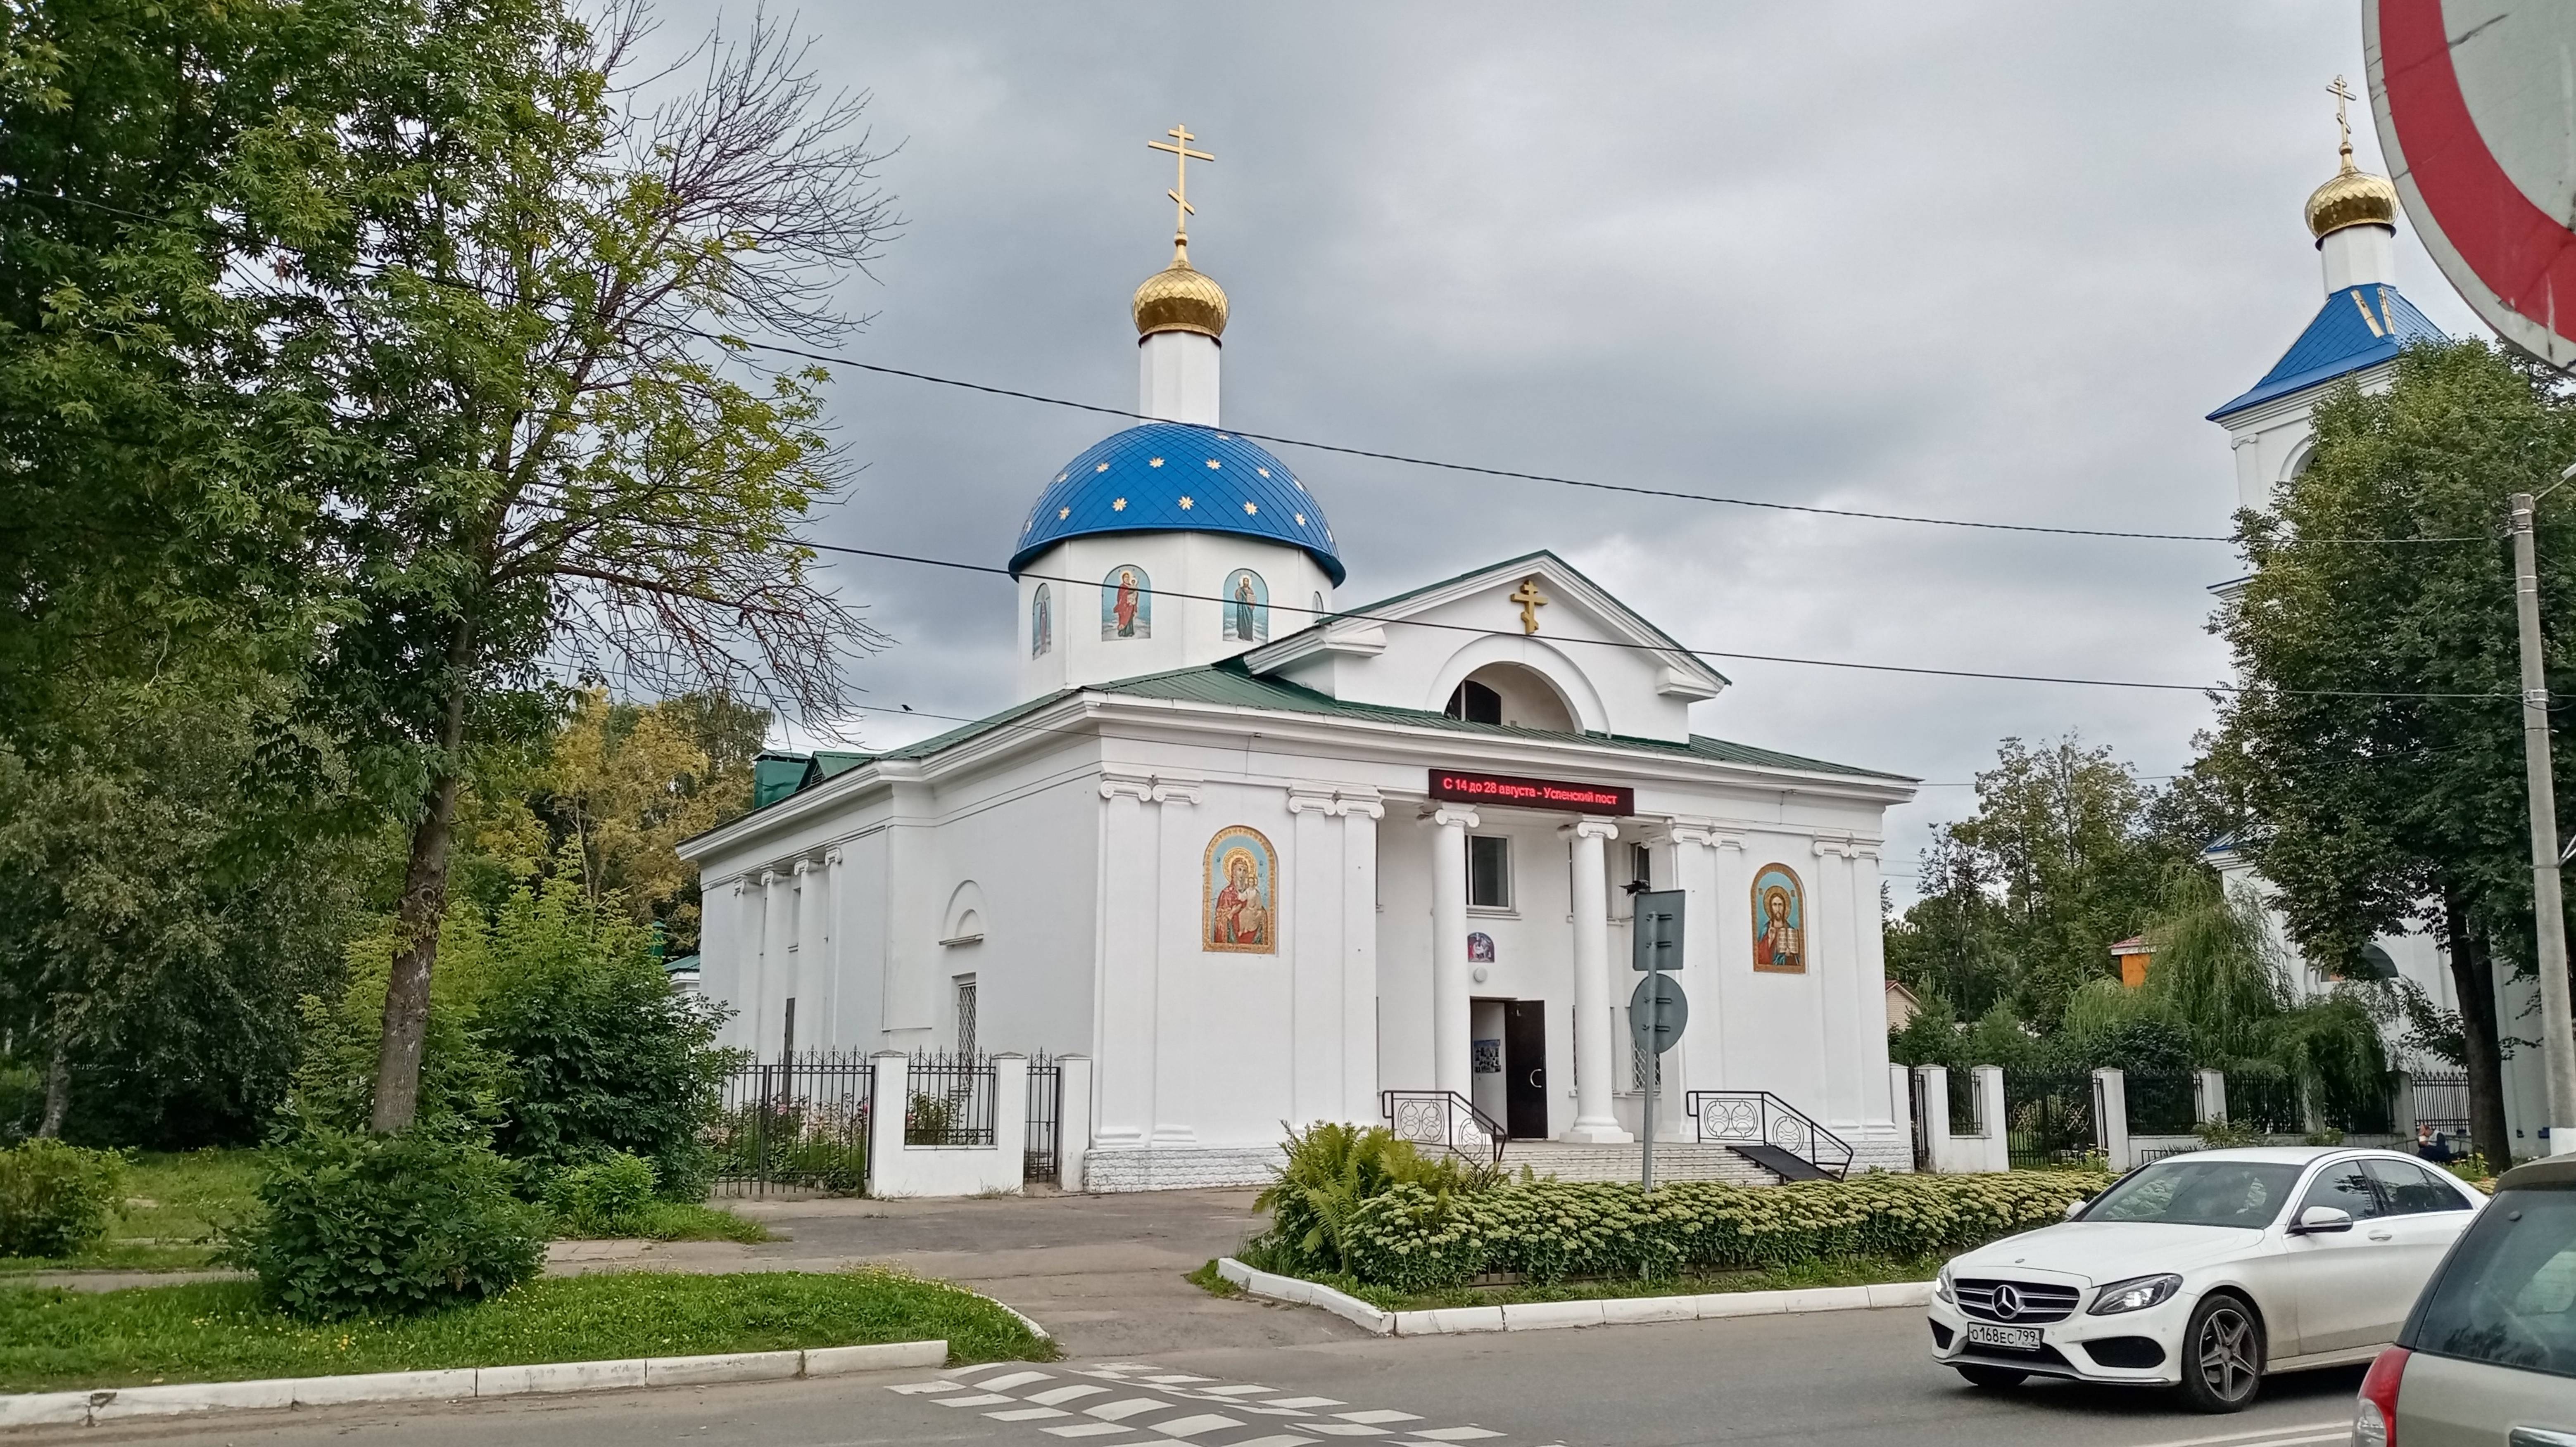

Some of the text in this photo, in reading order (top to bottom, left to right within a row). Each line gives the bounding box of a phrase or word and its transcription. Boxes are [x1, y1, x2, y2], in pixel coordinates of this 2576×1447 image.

[1443, 778, 1453, 790] С
[1455, 779, 1467, 791] 14
[1469, 782, 1483, 793] до
[1484, 781, 1497, 794] 28
[1499, 785, 1535, 798] августа
[1543, 787, 1594, 802] Успенский
[1595, 794, 1617, 804] пост
[2016, 1329, 2036, 1342] 799
